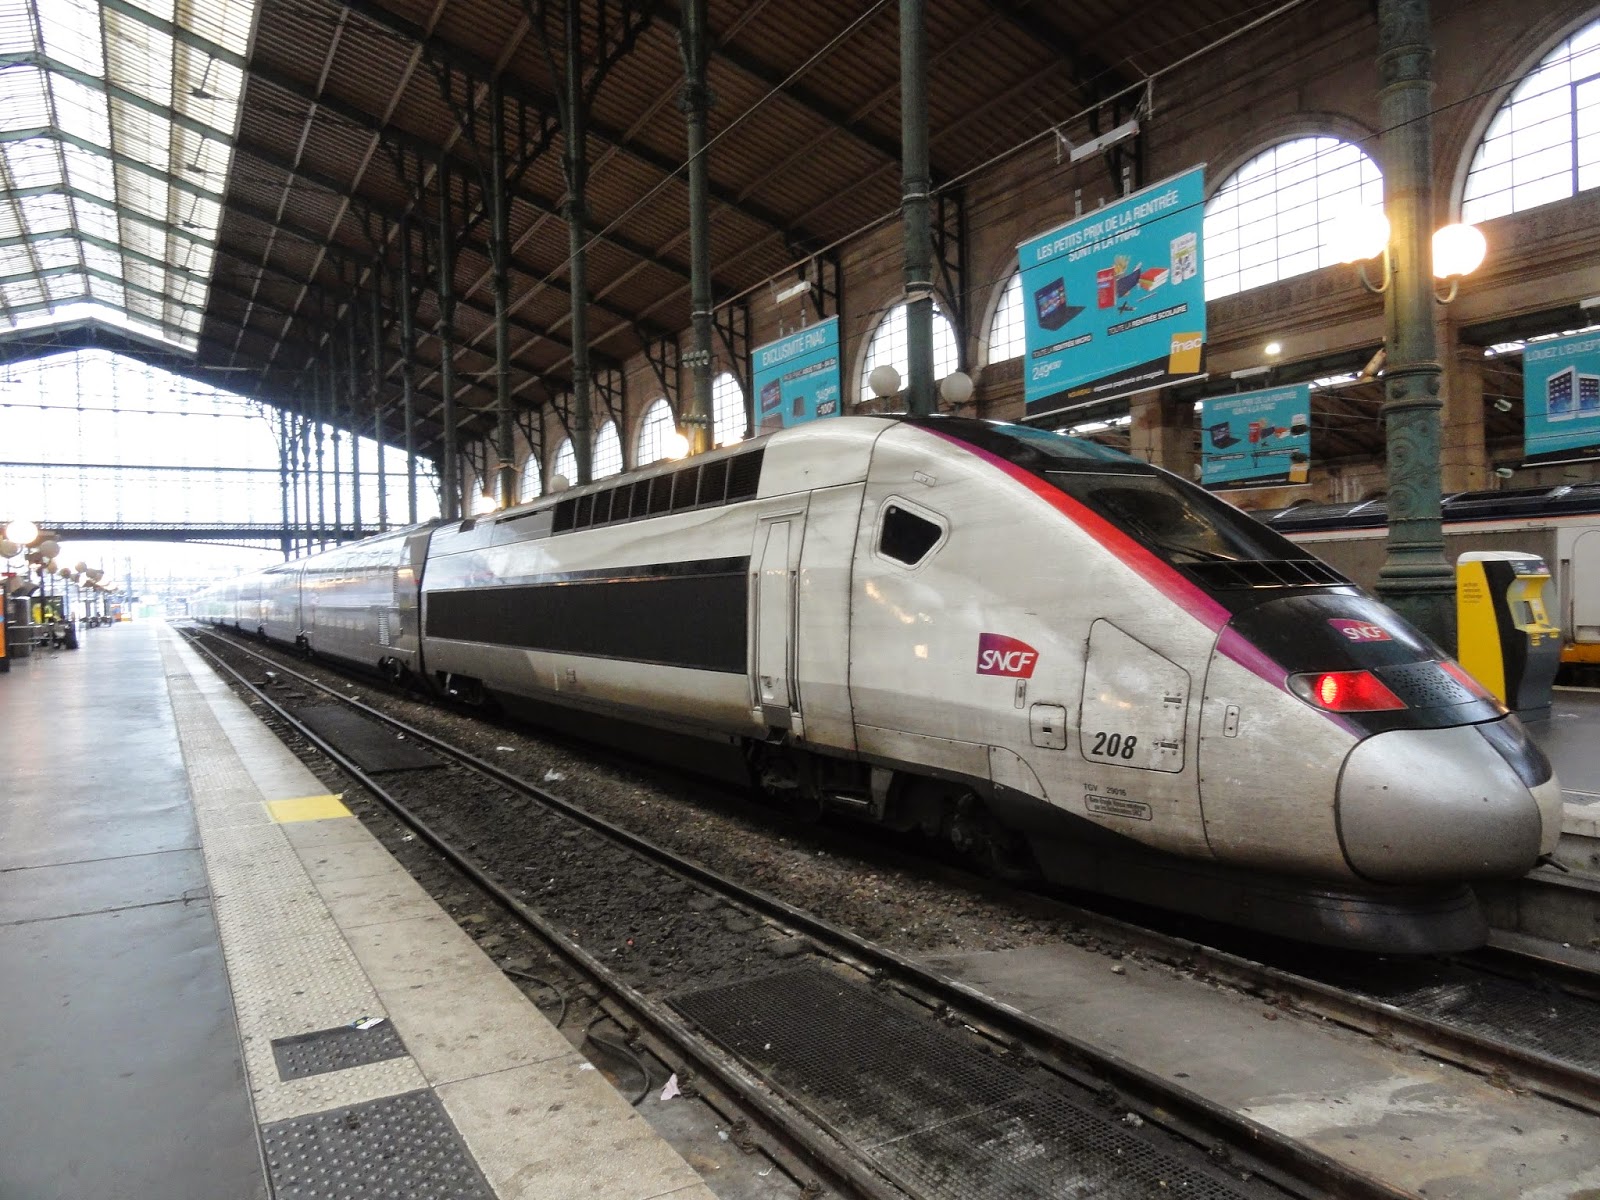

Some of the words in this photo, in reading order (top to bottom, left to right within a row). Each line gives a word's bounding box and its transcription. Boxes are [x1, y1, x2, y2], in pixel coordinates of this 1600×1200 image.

[1036, 243, 1053, 260] LES
[1054, 231, 1081, 253] PETITS
[1083, 222, 1104, 241] PRIX
[1105, 215, 1119, 232] DE
[1120, 210, 1133, 226] LA
[1133, 190, 1179, 219] RENTRÉE
[1068, 242, 1092, 262] SONT
[1171, 338, 1202, 355] fnac
[1343, 626, 1382, 640] SNCF
[978, 649, 1035, 672] SNCF
[1091, 731, 1137, 759] 208
[1083, 782, 1098, 792] TGV
